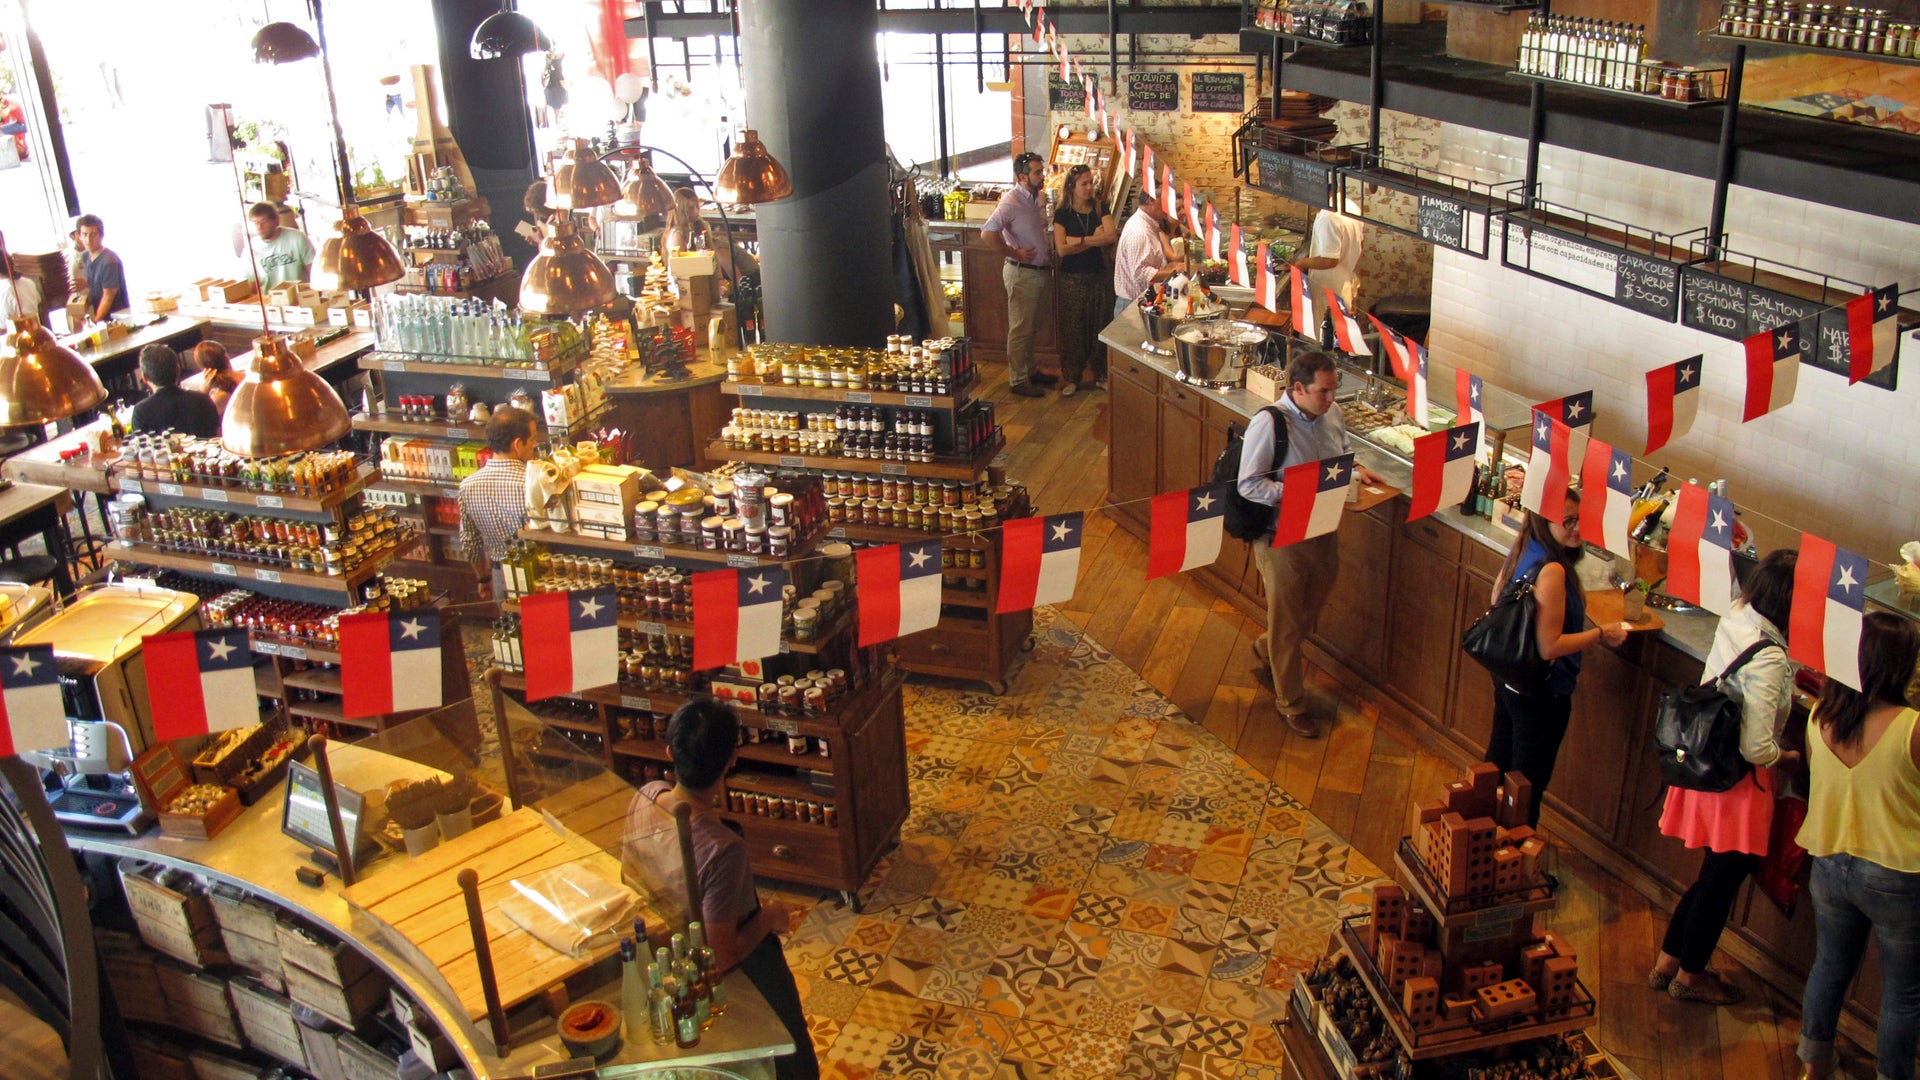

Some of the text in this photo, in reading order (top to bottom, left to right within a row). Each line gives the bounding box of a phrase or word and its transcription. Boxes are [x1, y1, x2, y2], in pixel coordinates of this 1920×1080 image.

[1130, 73, 1172, 83] NO OLVIDE
[1060, 90, 1085, 98] TODAS
[1130, 91, 1156, 99] ANTES
[1132, 101, 1168, 110] COMER
[1422, 195, 1460, 215] FIAMBRE
[1750, 294, 1803, 318] SALMON
